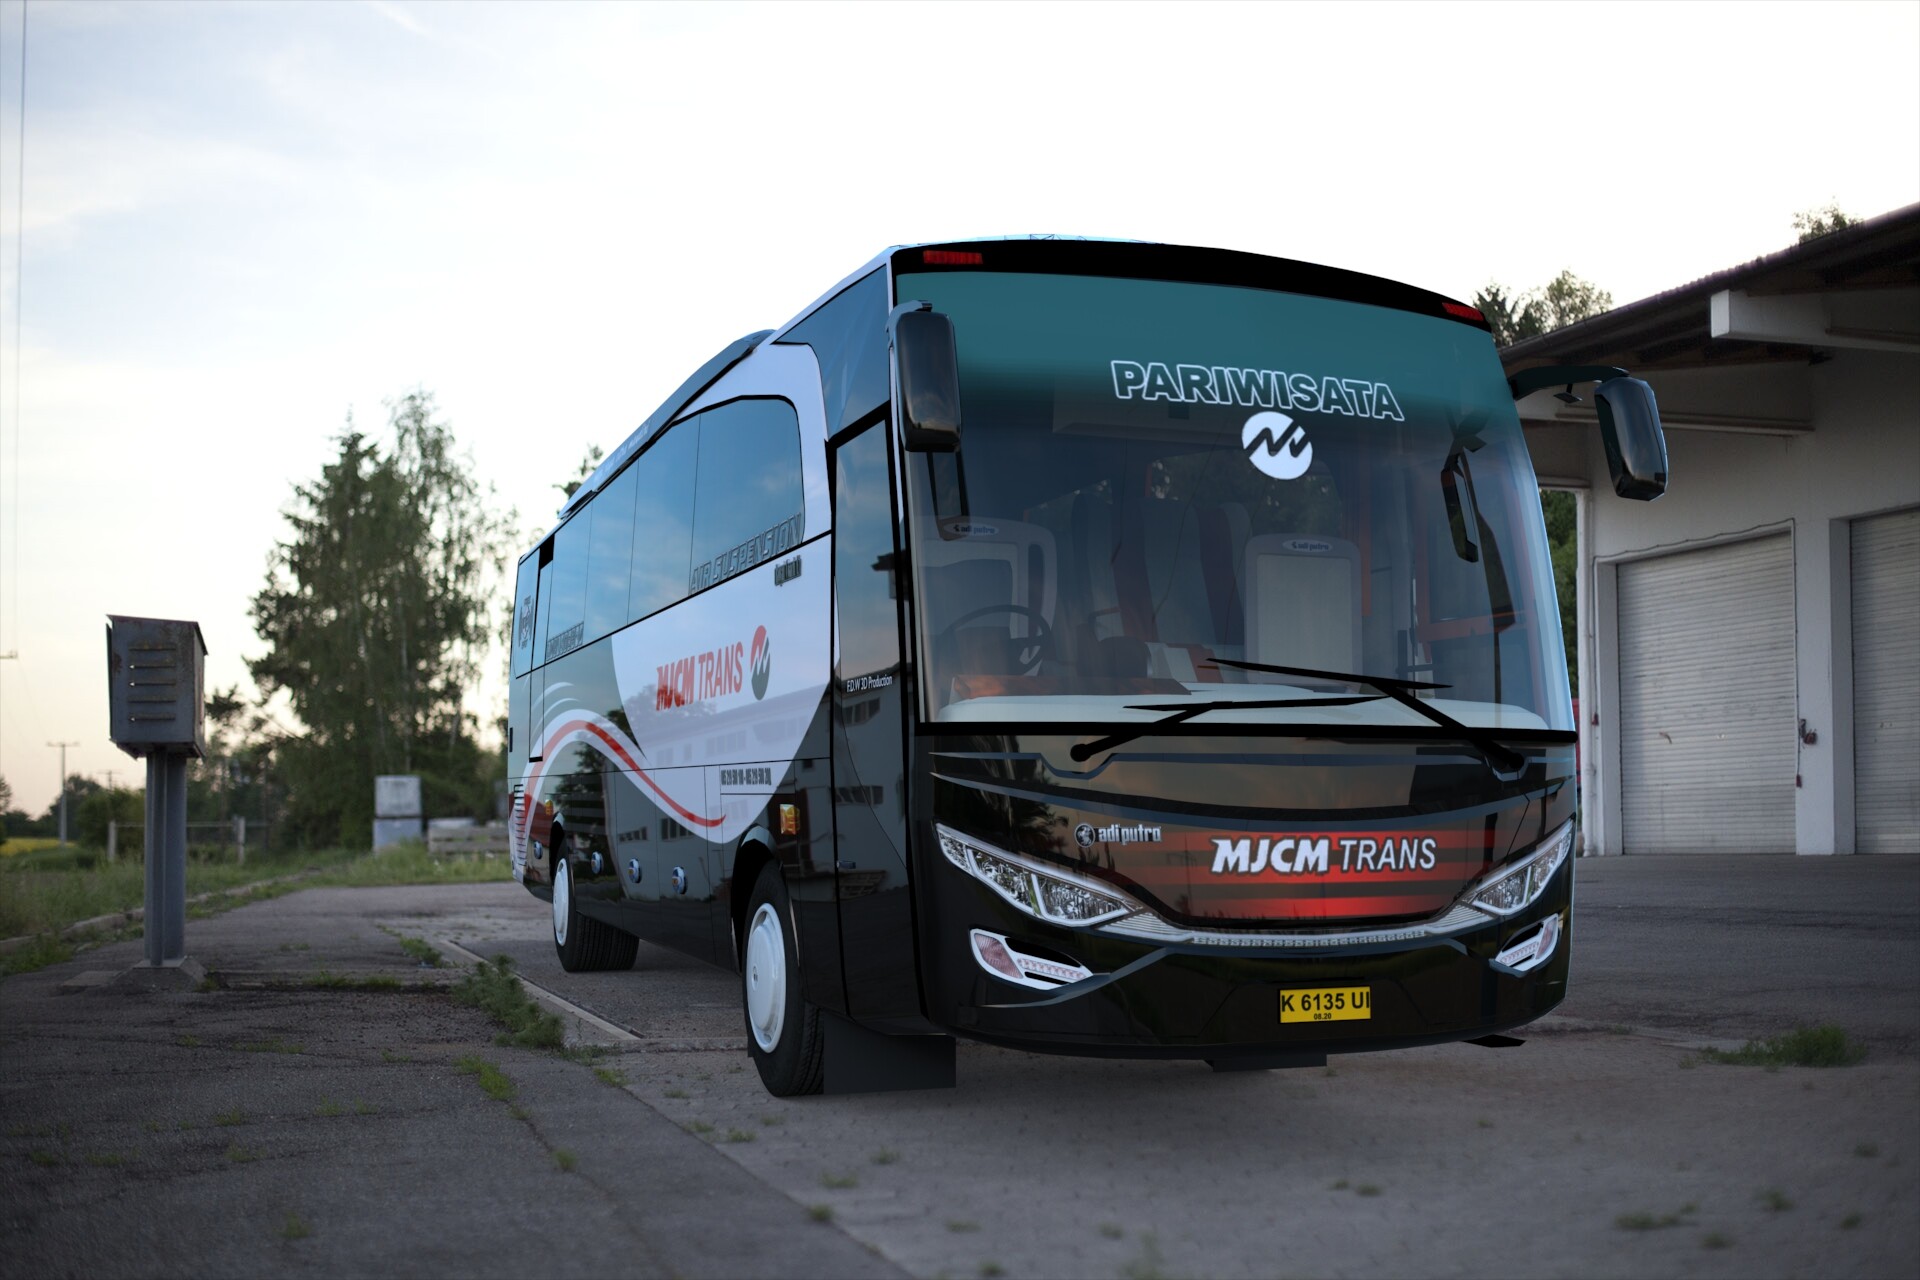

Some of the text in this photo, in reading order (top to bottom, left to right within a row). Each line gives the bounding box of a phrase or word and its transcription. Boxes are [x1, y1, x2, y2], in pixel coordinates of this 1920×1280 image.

[1111, 360, 1405, 422] PARIWISATA
[689, 561, 711, 595] AIR
[712, 512, 802, 582] SUSPENSION
[656, 641, 744, 711] MJCM TRANS
[868, 674, 893, 689] Production
[1211, 838, 1437, 873] MJCM TRANS
[1281, 994, 1295, 1012] K
[1301, 993, 1345, 1011] 6135
[1313, 1013, 1332, 1021] 08.20
